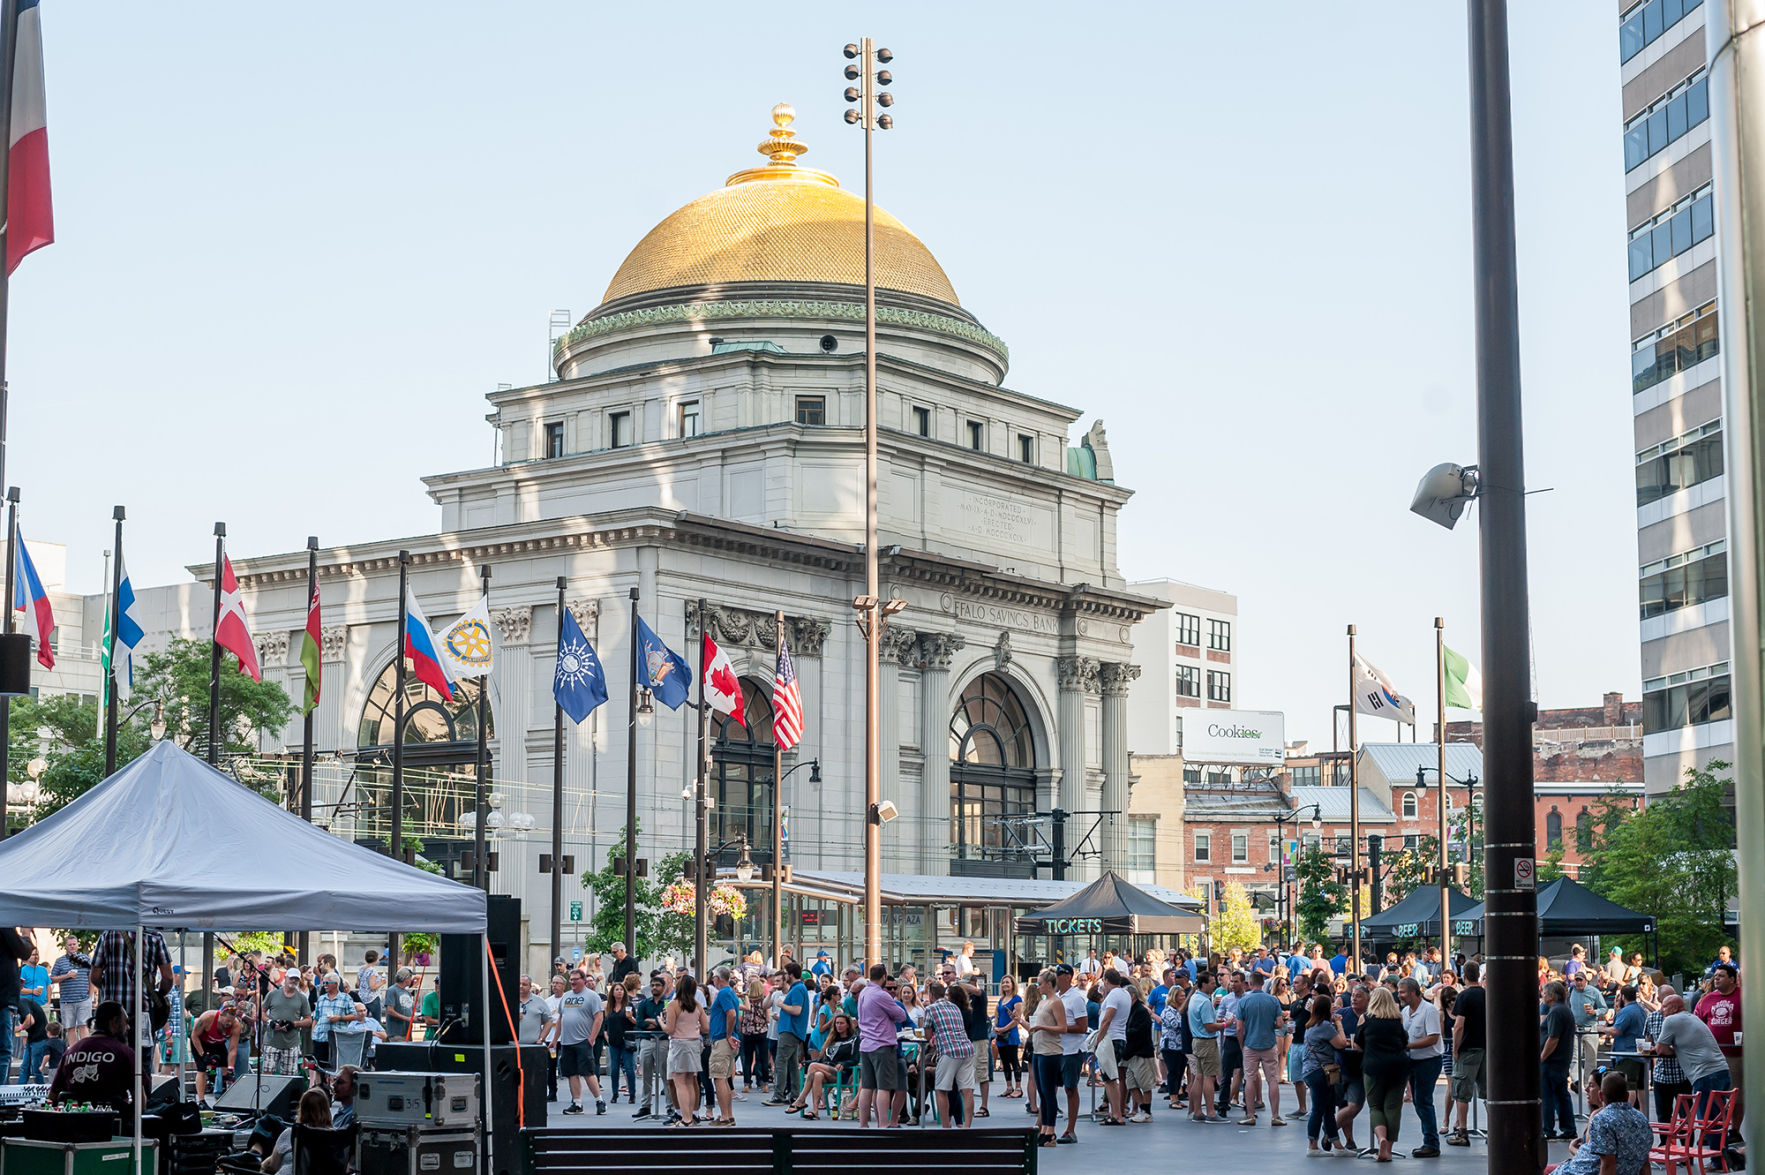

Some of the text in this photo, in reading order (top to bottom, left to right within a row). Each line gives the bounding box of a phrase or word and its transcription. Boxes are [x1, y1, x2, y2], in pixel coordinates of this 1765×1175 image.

[954, 601, 1059, 633] FFALO SAVINGS BANK
[1045, 919, 1102, 934] TICKETS
[1398, 923, 1418, 938] BEER
[1455, 921, 1474, 936] BEER
[65, 1051, 116, 1066] INDIGO
